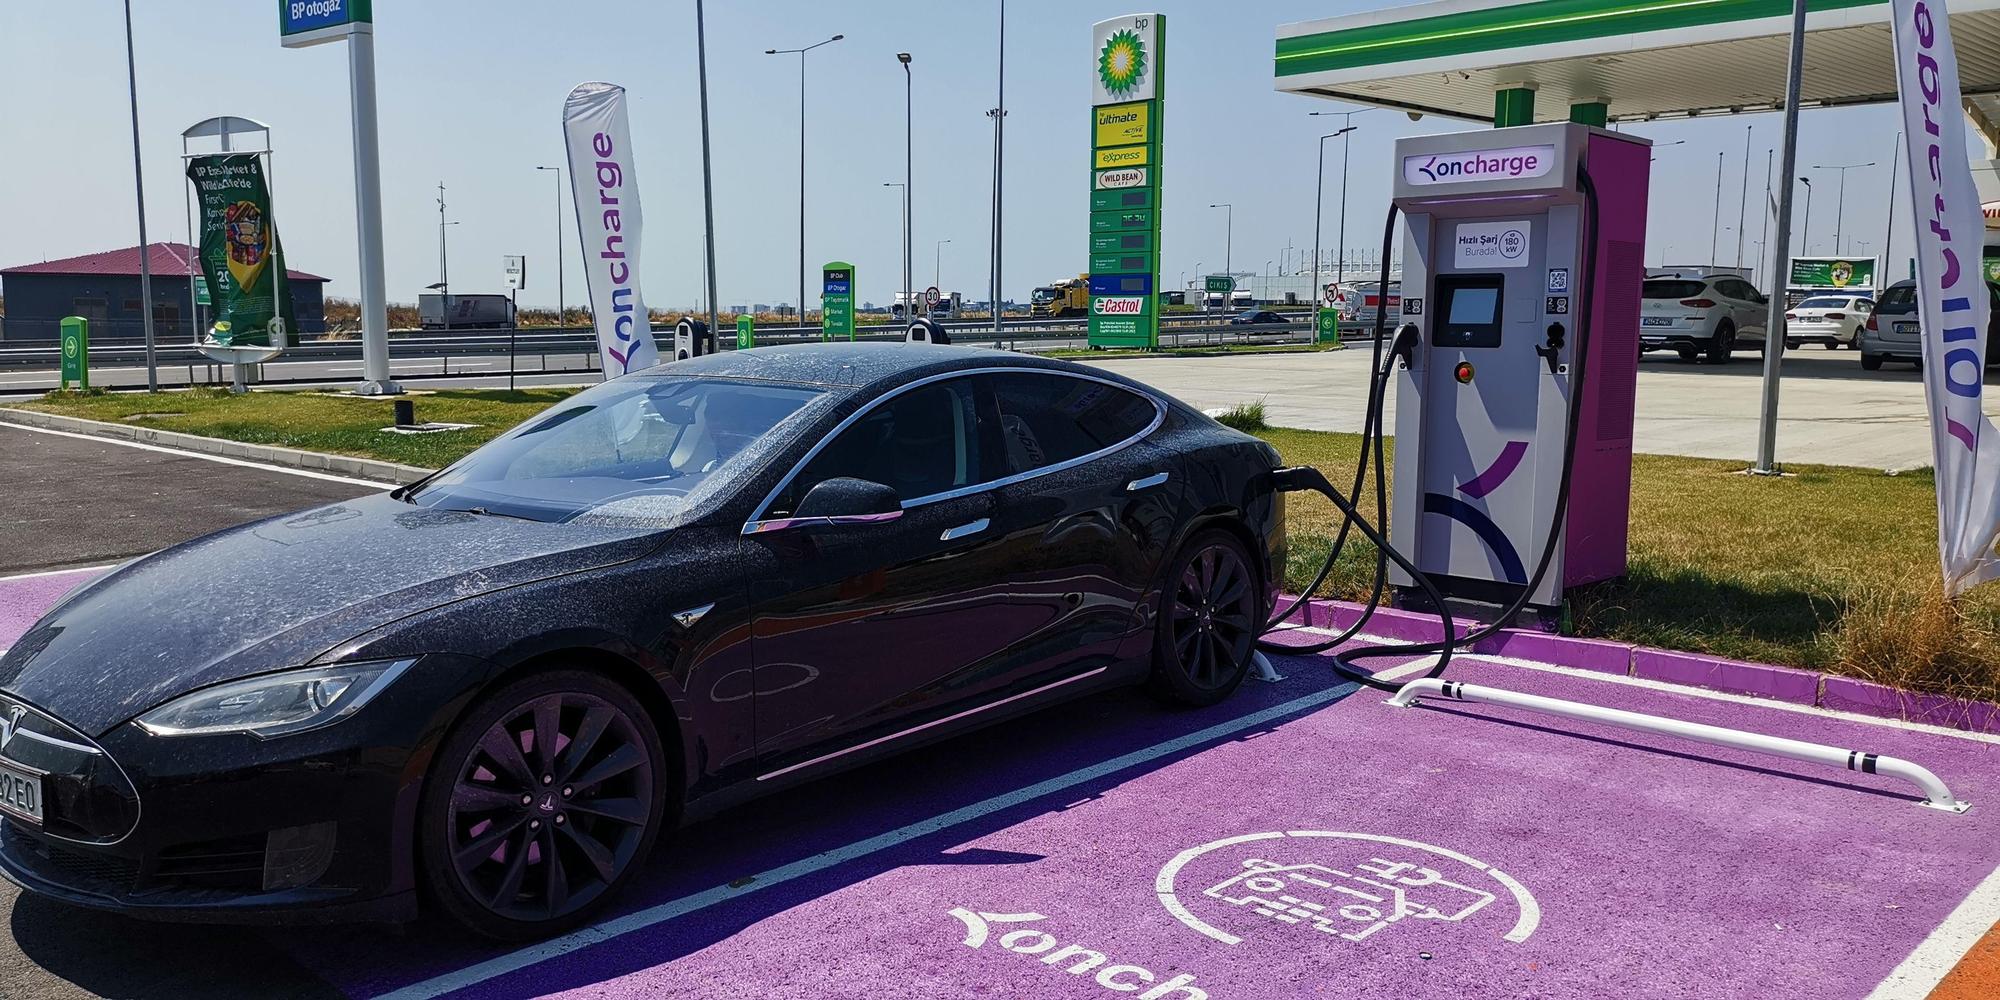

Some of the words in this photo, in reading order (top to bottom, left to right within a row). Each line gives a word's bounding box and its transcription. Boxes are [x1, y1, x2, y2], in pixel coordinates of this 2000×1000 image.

[291, 2, 306, 20] BP
[306, 0, 341, 17] otogaz
[1135, 17, 1148, 30] bp
[1099, 112, 1138, 125] ultimate
[1102, 152, 1140, 163] express
[1436, 154, 1538, 177] oncharge
[1104, 173, 1121, 182] WILD
[1121, 173, 1139, 181] BEAN
[592, 131, 634, 342] oncharge
[1458, 235, 1479, 245] Hızlı
[1480, 234, 1498, 245] Şarj
[1504, 237, 1519, 246] 180
[1465, 246, 1498, 256] Burada!
[928, 291, 937, 301] 30
[1548, 297, 1553, 305] 2
[1104, 297, 1140, 313] Castrol
[0, 773, 35, 812] 2EO
